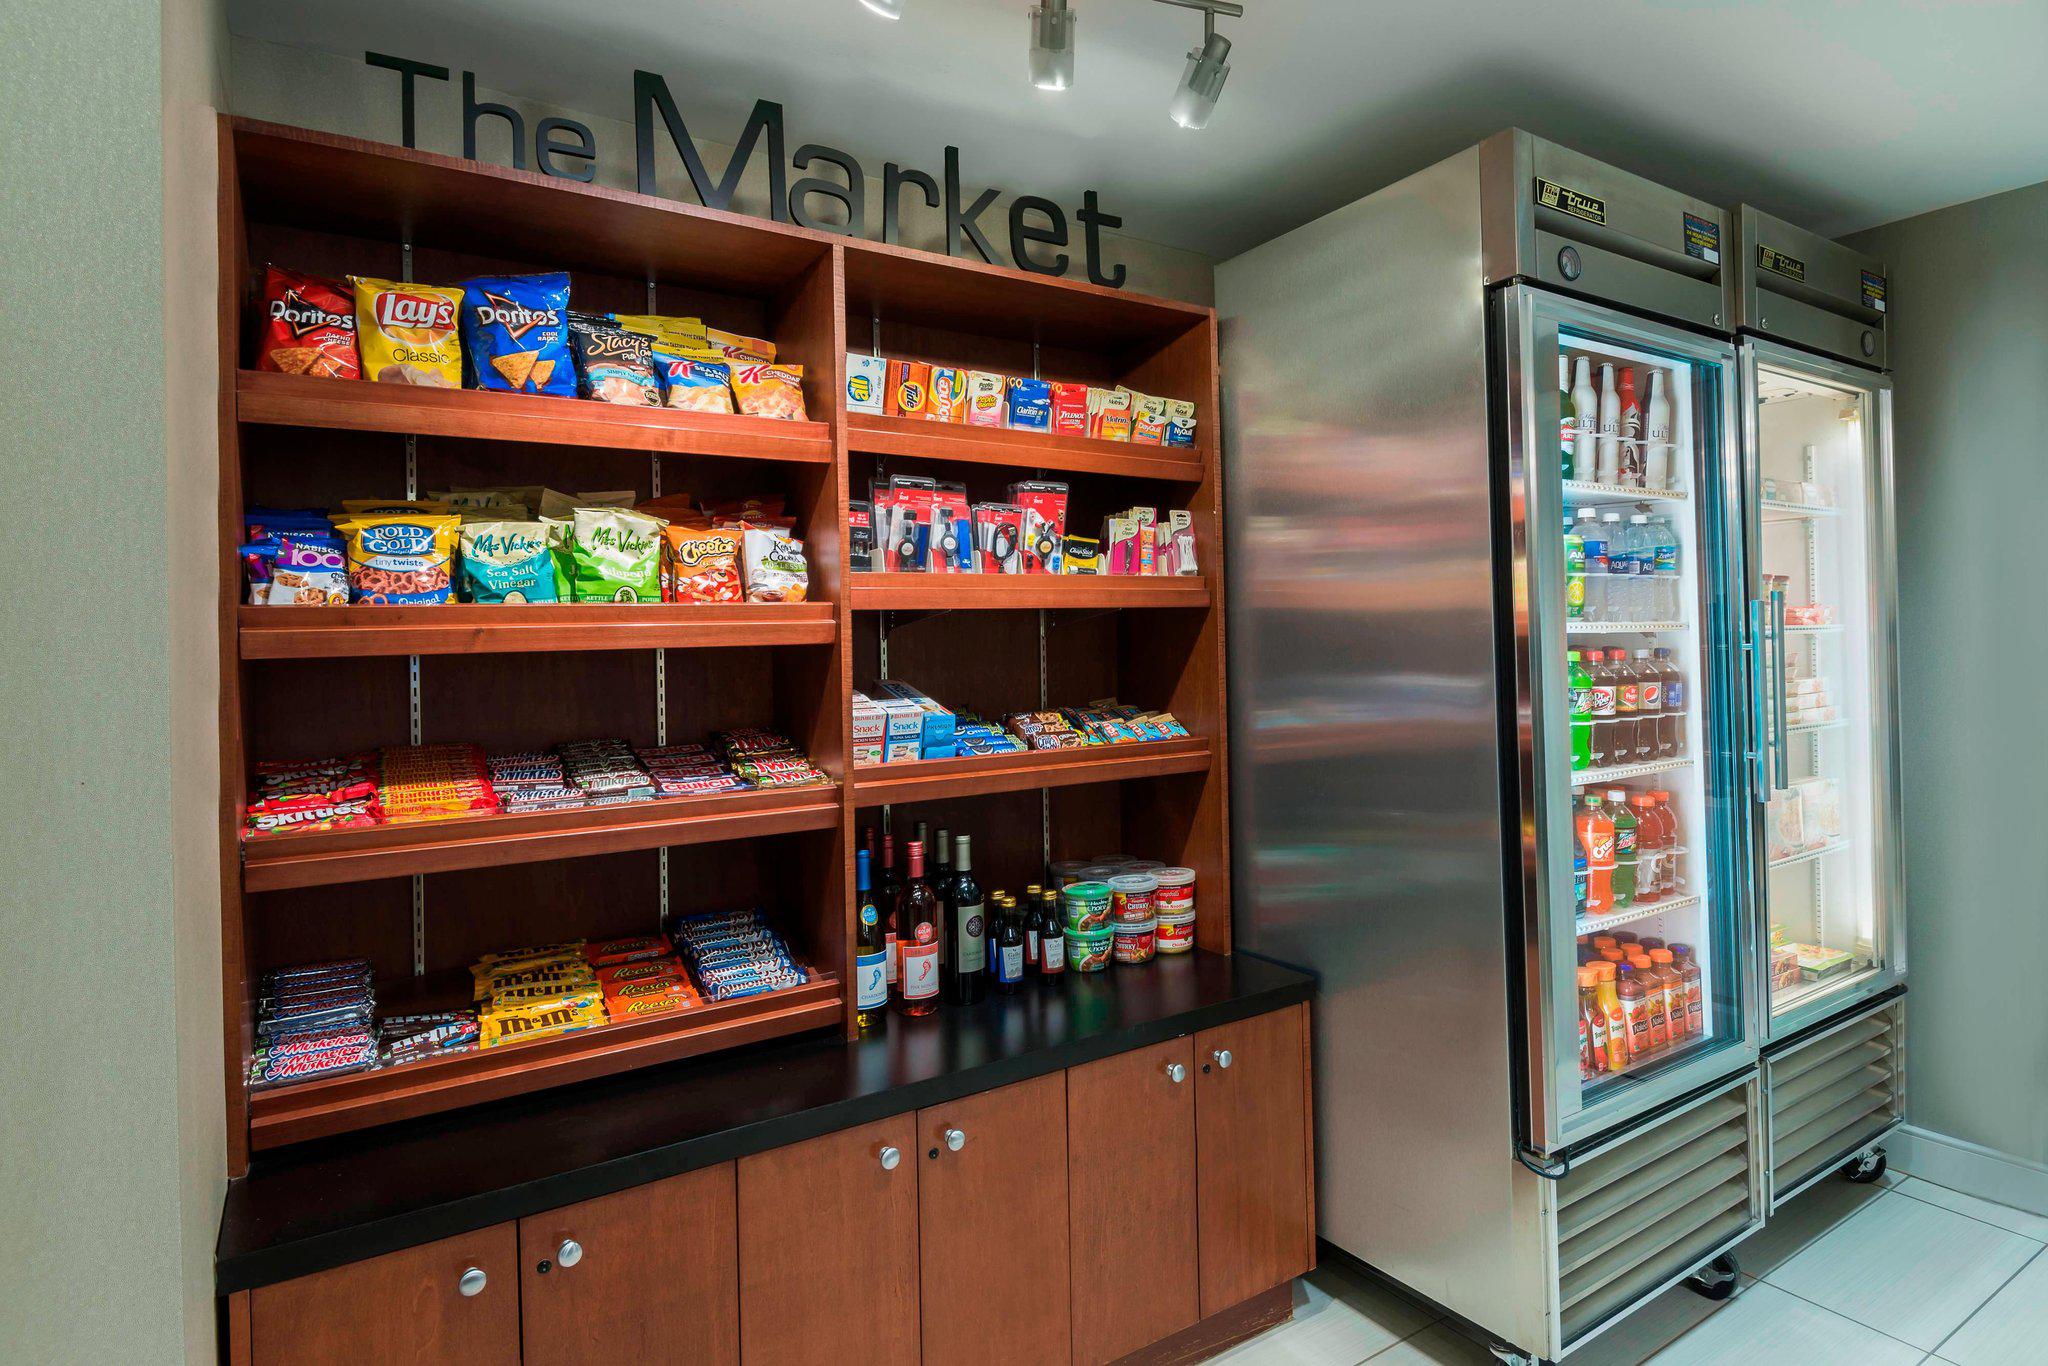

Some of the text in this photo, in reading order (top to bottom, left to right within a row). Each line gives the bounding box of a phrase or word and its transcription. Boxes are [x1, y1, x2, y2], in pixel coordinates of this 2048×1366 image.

[365, 51, 1126, 288] The Market
[269, 300, 354, 329] Doritos
[382, 293, 454, 328] Lay's
[477, 306, 560, 326] Doritos
[587, 332, 649, 357] Stacy's
[392, 348, 450, 364] Classic
[904, 384, 919, 408] Tide
[373, 527, 424, 539] ROLD
[295, 542, 342, 554] NABISCO
[369, 538, 429, 552] GOLD
[679, 537, 735, 565] Cheetos
[291, 548, 345, 569] 100
[375, 559, 424, 568] tiny twists
[486, 565, 540, 578] Sea Salt
[488, 577, 536, 591] Vinegar
[853, 724, 881, 734] Snack
[893, 722, 920, 732] Snack
[665, 778, 734, 791] CRUNCH
[770, 768, 825, 785] TWIX
[256, 806, 367, 830] Skittles
[617, 980, 671, 997] Reese's
[717, 975, 772, 998] Almond
[626, 997, 681, 1013] Reese's
[286, 1034, 371, 1055] Musketeers
